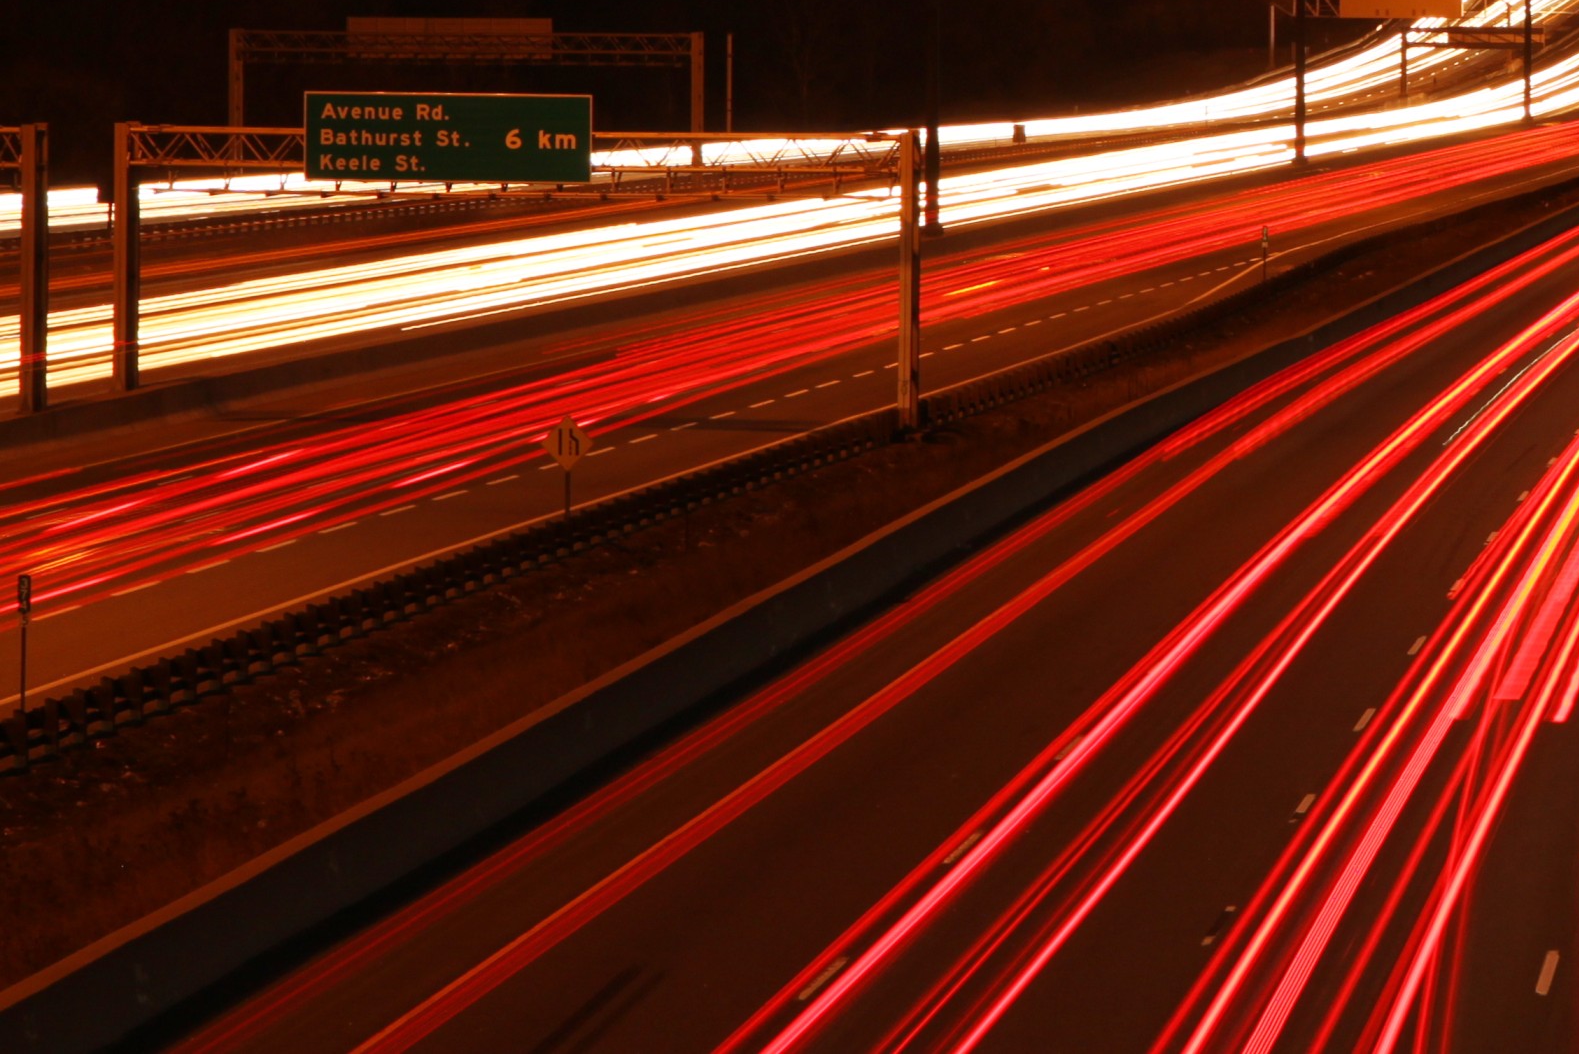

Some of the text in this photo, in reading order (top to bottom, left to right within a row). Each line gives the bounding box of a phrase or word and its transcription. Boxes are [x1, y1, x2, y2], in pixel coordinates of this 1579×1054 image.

[321, 102, 450, 121] Avenue Rd.
[319, 129, 470, 147] Bathurst St.
[505, 129, 577, 150] 6 km
[319, 154, 426, 172] Keele St.
